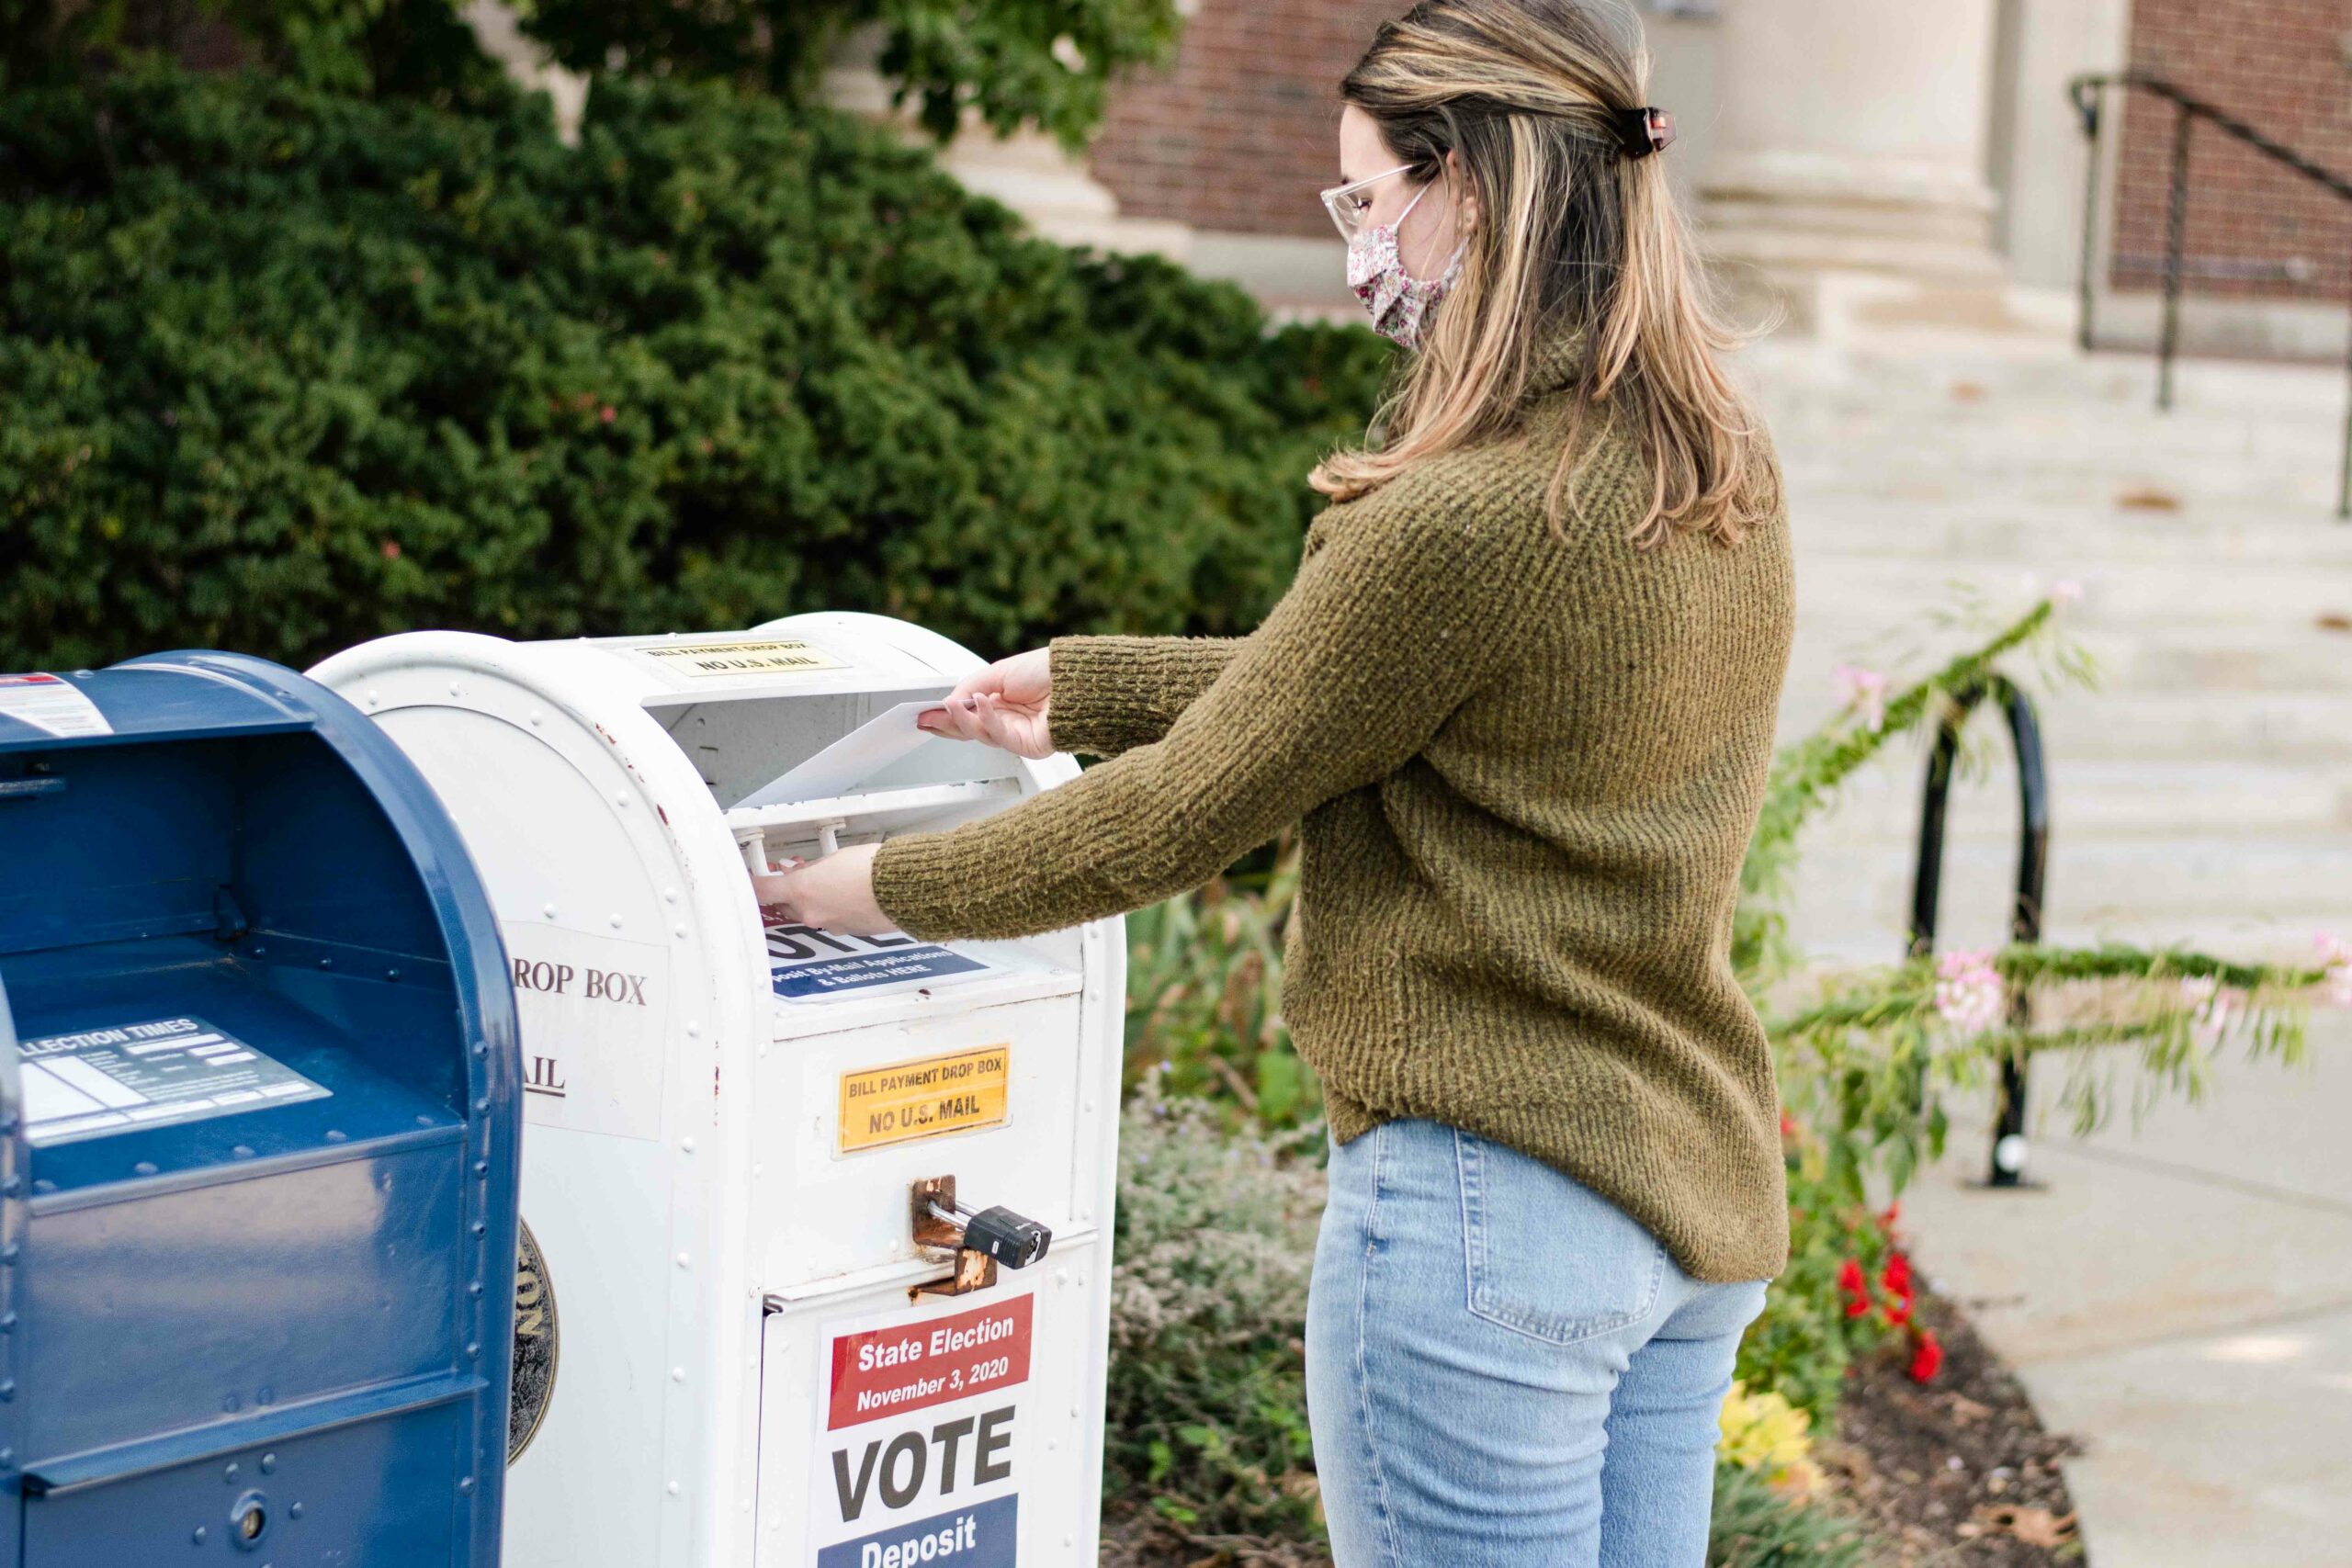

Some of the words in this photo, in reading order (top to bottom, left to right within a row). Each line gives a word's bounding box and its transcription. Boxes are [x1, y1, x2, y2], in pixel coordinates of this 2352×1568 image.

[679, 646, 743, 656] PAYMENT
[695, 660, 729, 671] NO
[729, 659, 771, 669] U.S.
[772, 656, 820, 666] MAIL
[764, 926, 917, 960] OT
[513, 957, 574, 994] ROP
[583, 968, 647, 1006] BOX
[772, 969, 810, 983] posit
[805, 961, 863, 976] By-Mail
[865, 950, 955, 968] Applications
[818, 978, 836, 987] &
[831, 971, 888, 984] Ballots
[887, 964, 932, 976] HERE
[17, 1029, 130, 1057] LLECTION
[124, 1018, 198, 1039] TIMES
[849, 1081, 876, 1098] BILL
[880, 1068, 939, 1092] PAYMENT
[942, 1062, 974, 1080] DROP
[978, 1057, 1001, 1073] BOX
[869, 1111, 895, 1134] NO
[901, 1104, 933, 1127] U.S.
[939, 1095, 980, 1120] MAIL
[858, 1337, 922, 1371] State
[929, 1316, 1013, 1357] Election
[857, 1375, 946, 1412] November
[949, 1369, 964, 1391] 3,
[969, 1356, 1009, 1384] 2020
[831, 1404, 1016, 1523] VOTE
[862, 1514, 977, 1568] Deposit
